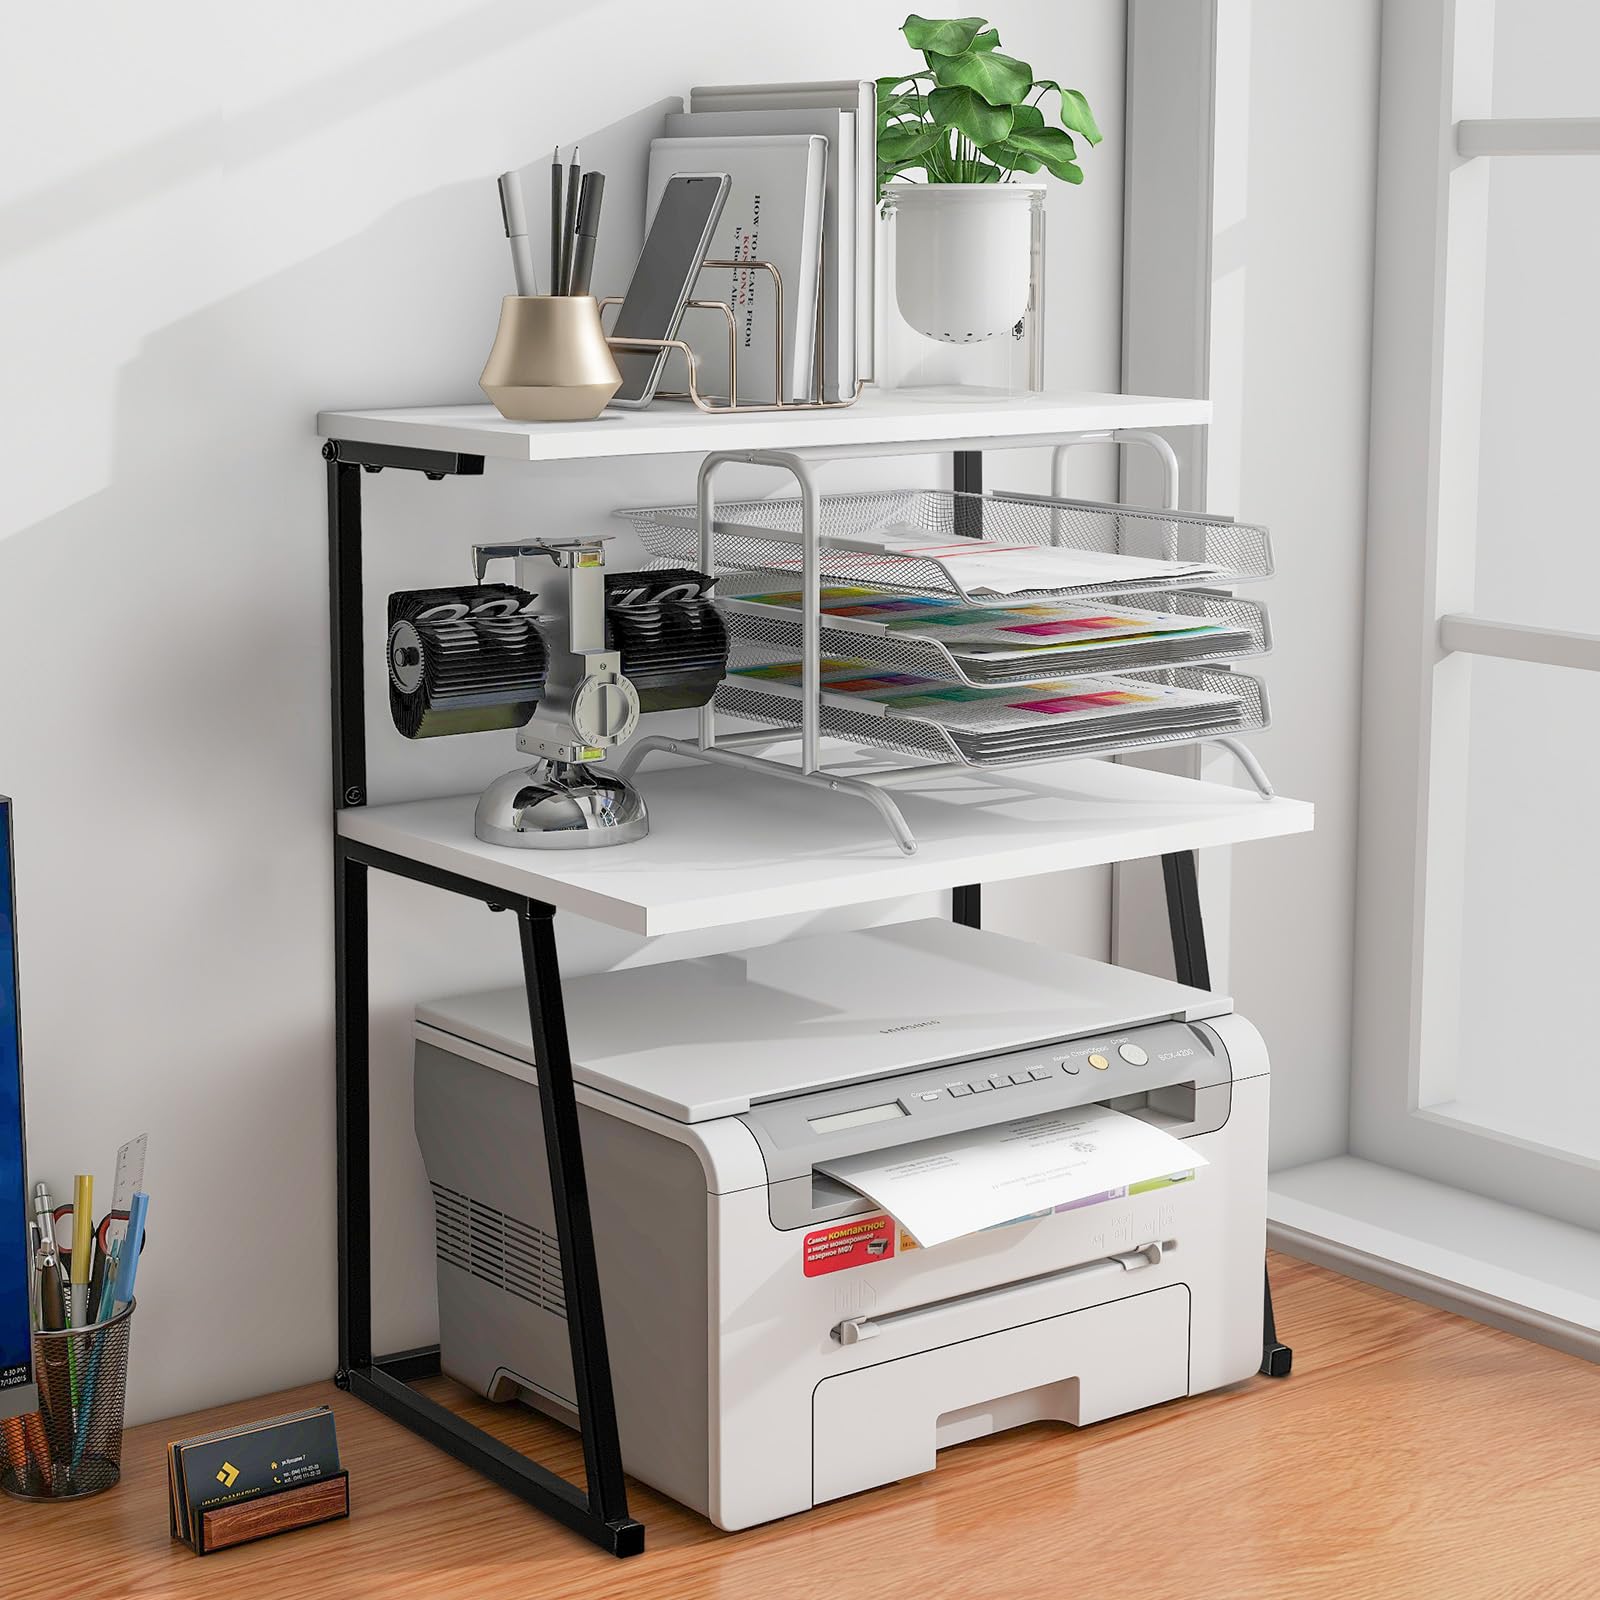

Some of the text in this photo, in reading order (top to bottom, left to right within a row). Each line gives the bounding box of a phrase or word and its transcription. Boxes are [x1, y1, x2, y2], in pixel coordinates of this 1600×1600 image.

[733, 227, 742, 240] by
[733, 245, 741, 282] Rusel
[739, 235, 750, 305] KOSONAY
[745, 195, 761, 347] HOW TO ECAPE FROM
[807, 1236, 828, 1246] Самое
